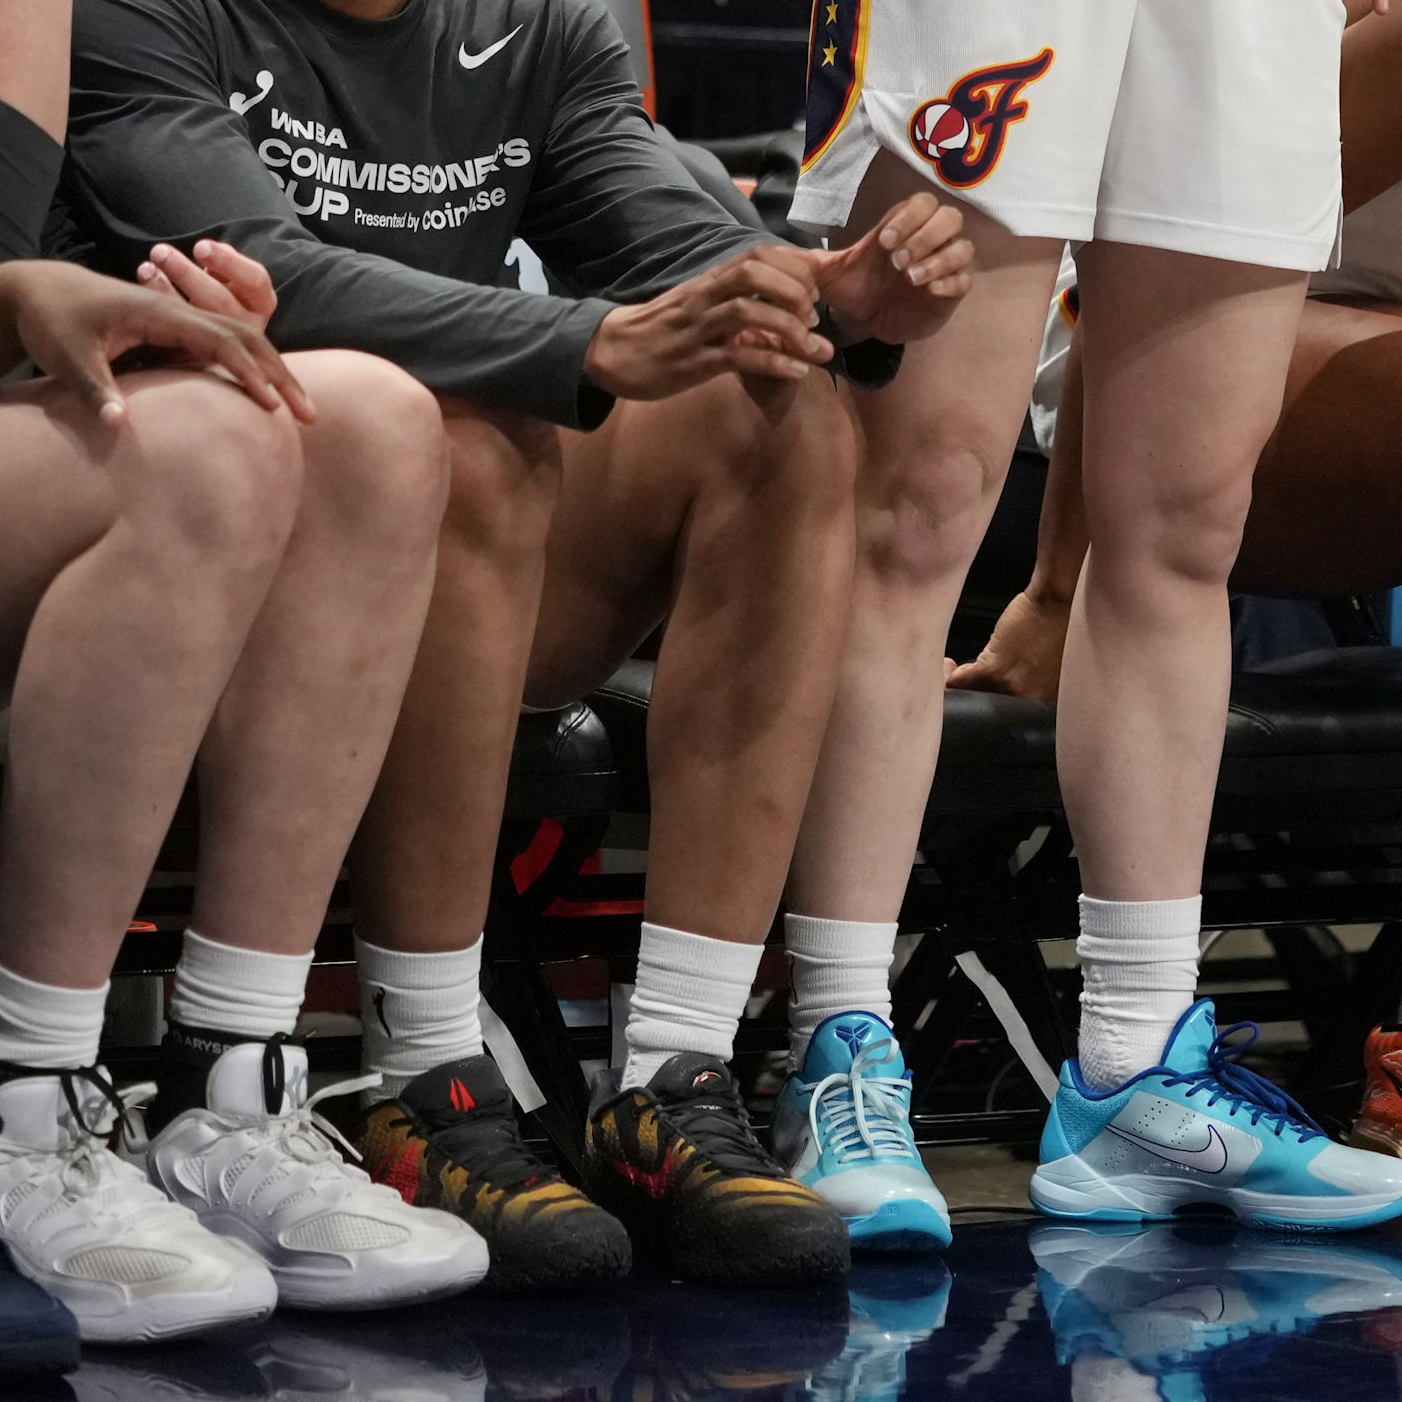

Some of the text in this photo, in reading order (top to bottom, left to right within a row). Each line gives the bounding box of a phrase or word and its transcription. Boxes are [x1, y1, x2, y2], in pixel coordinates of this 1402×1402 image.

[270, 107, 348, 150] WNBA
[257, 137, 532, 195] COMMISSONE'S
[354, 207, 406, 230] Presented
[406, 212, 421, 233] by
[421, 187, 507, 233] coinse
